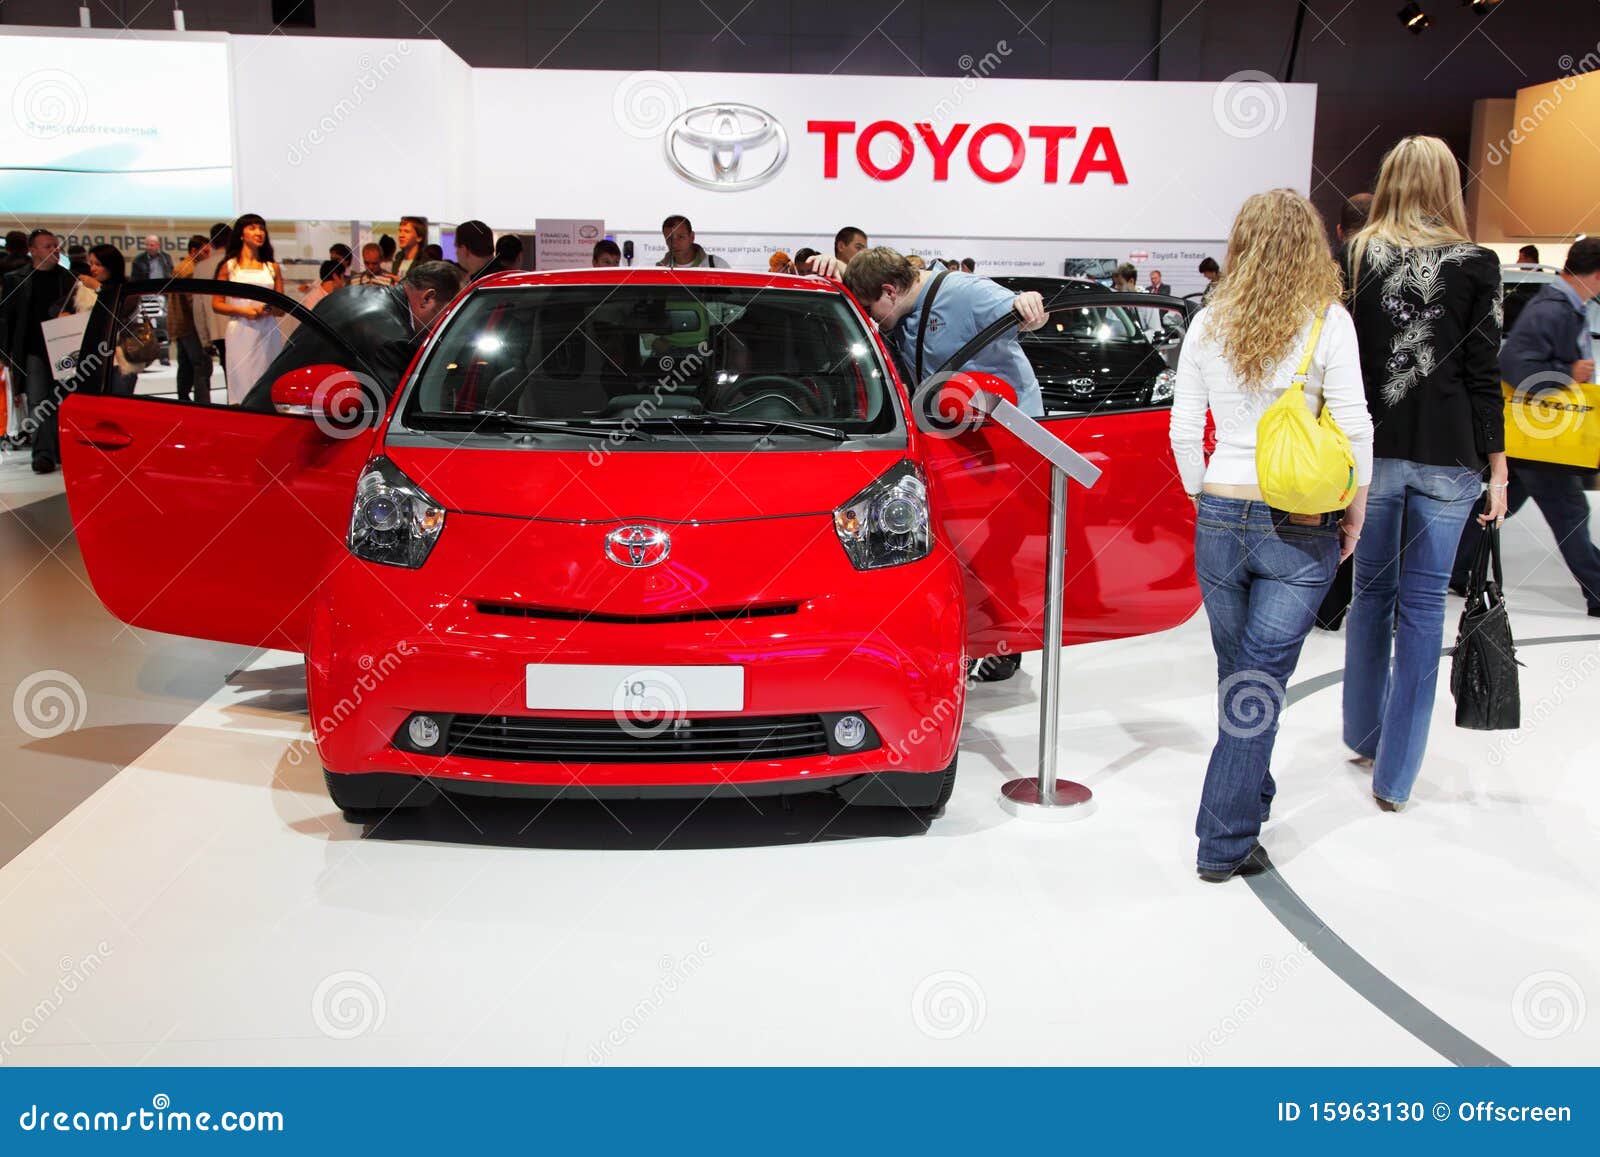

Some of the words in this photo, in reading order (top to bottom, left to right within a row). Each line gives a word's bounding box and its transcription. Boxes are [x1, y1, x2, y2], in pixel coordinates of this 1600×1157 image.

[807, 120, 1129, 185] TOYOTA
[1152, 252, 1178, 260] Toyota
[624, 680, 645, 698] iQ
